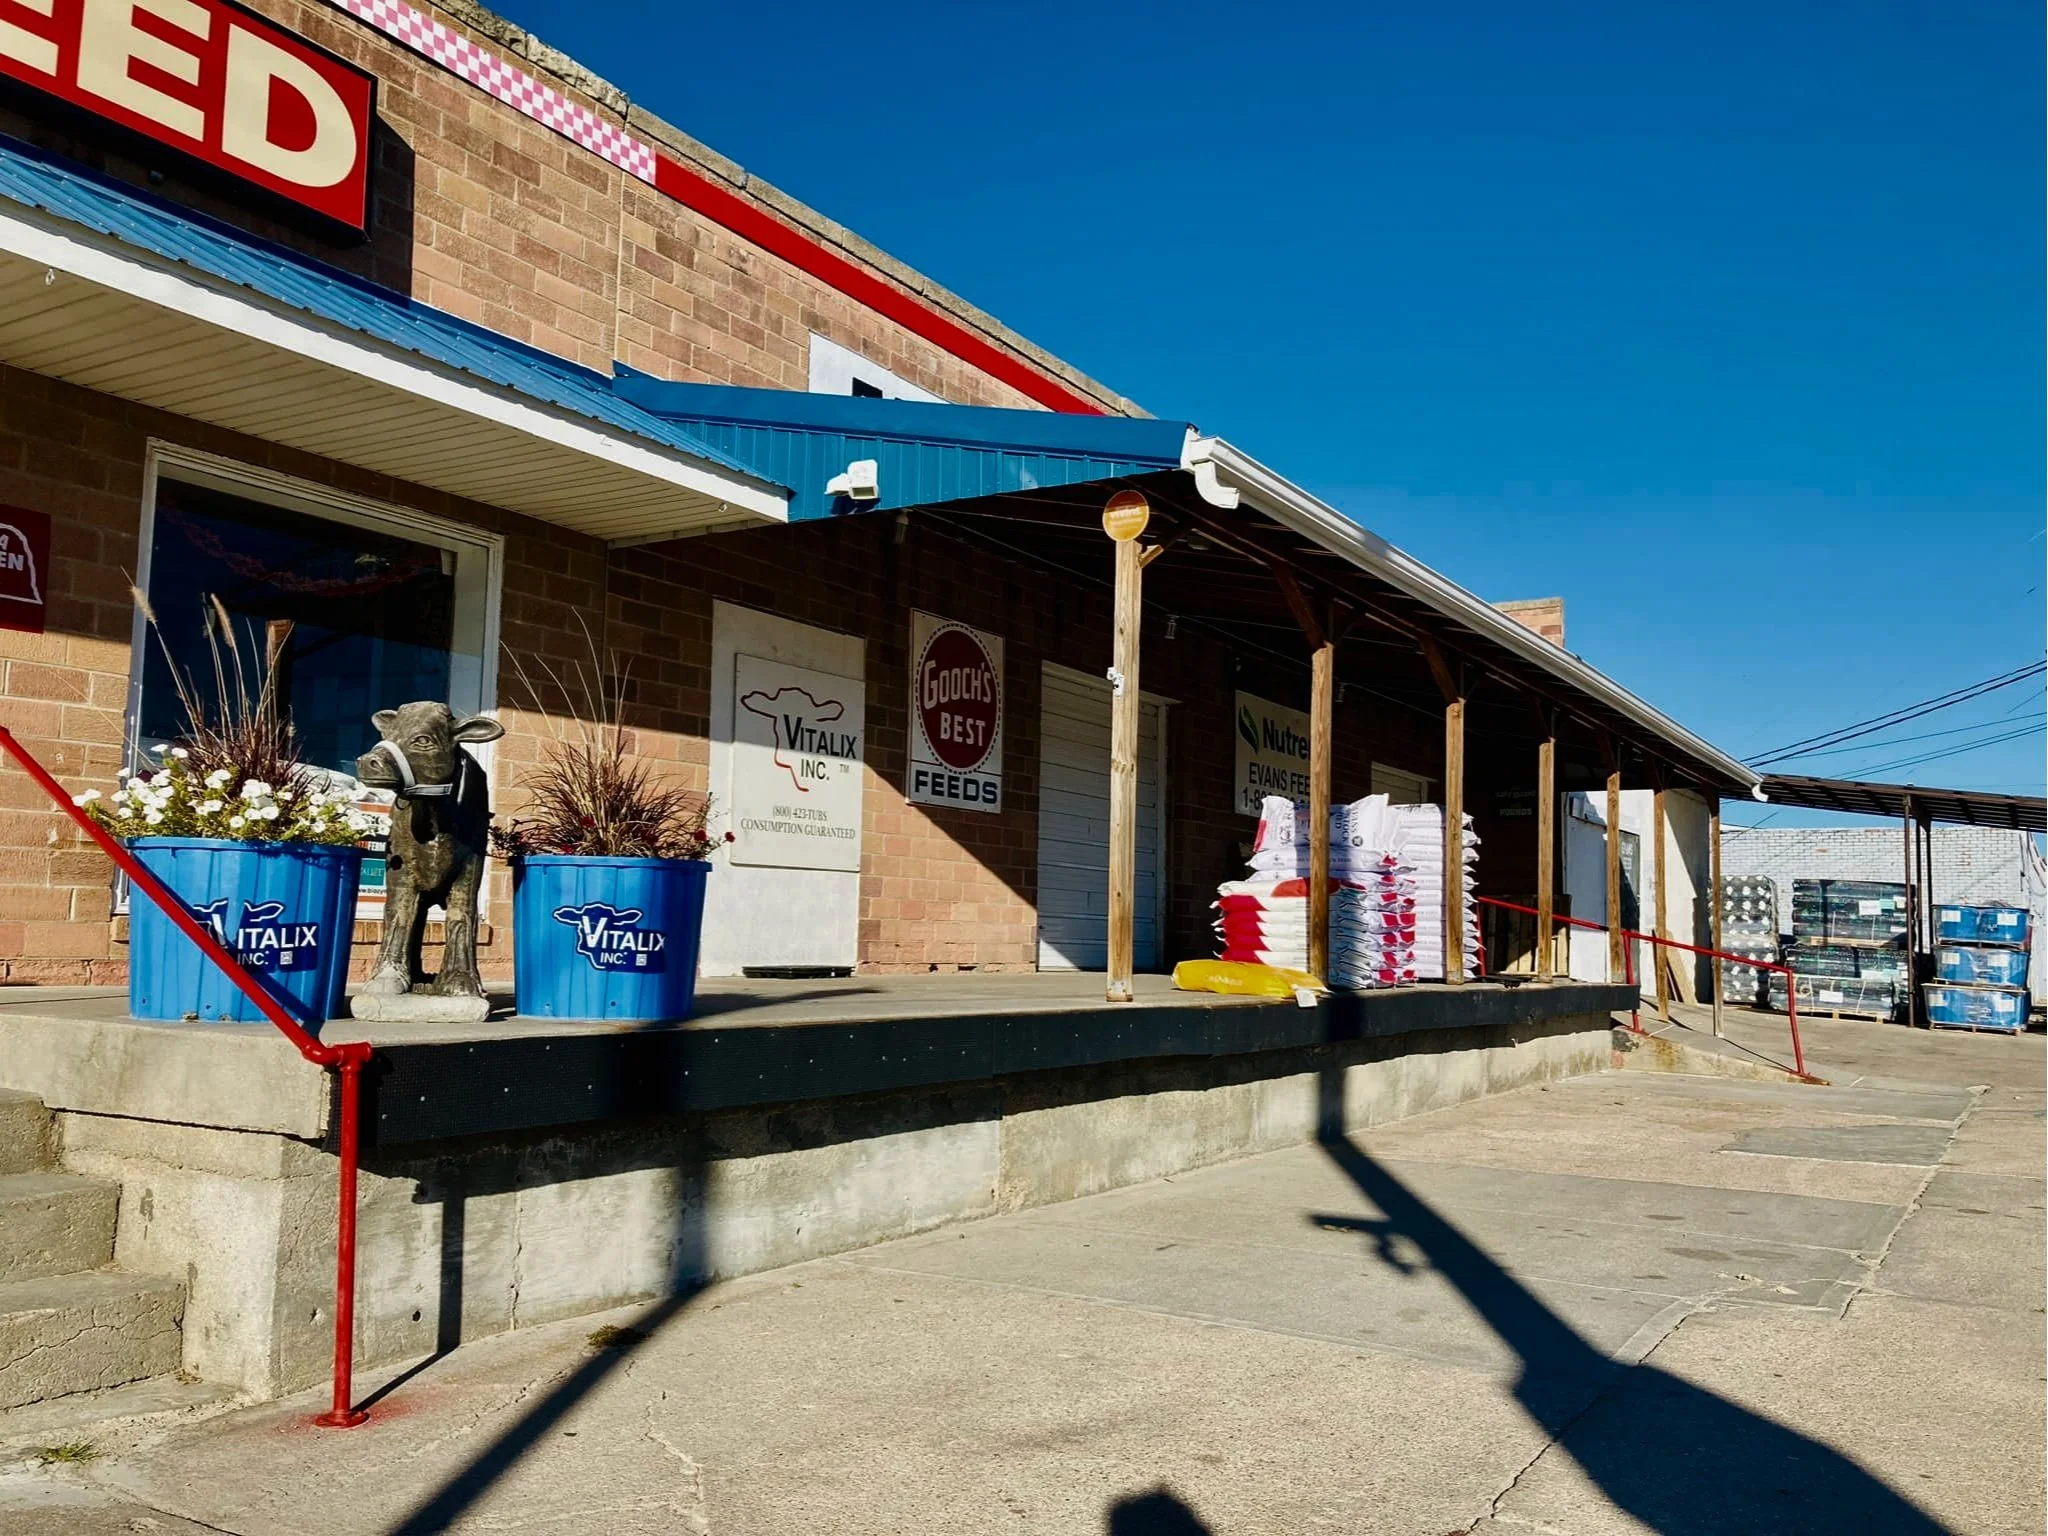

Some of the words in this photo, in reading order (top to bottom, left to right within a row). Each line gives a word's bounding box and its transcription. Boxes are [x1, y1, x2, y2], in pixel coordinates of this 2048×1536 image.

[923, 659, 992, 710] GOOCH'S
[783, 714, 857, 759] VITALIX
[940, 711, 986, 747] BEST
[1262, 717, 1312, 760] Nutre
[800, 758, 830, 781] INC.
[914, 769, 998, 804] FEEDS
[1248, 761, 1288, 791] EVANS
[1290, 772, 1311, 797] FEE
[740, 818, 803, 834] CONSUMPTION
[804, 824, 856, 840] GUARANTEED
[772, 805, 792, 818] (800)
[582, 915, 667, 951] VITALIX
